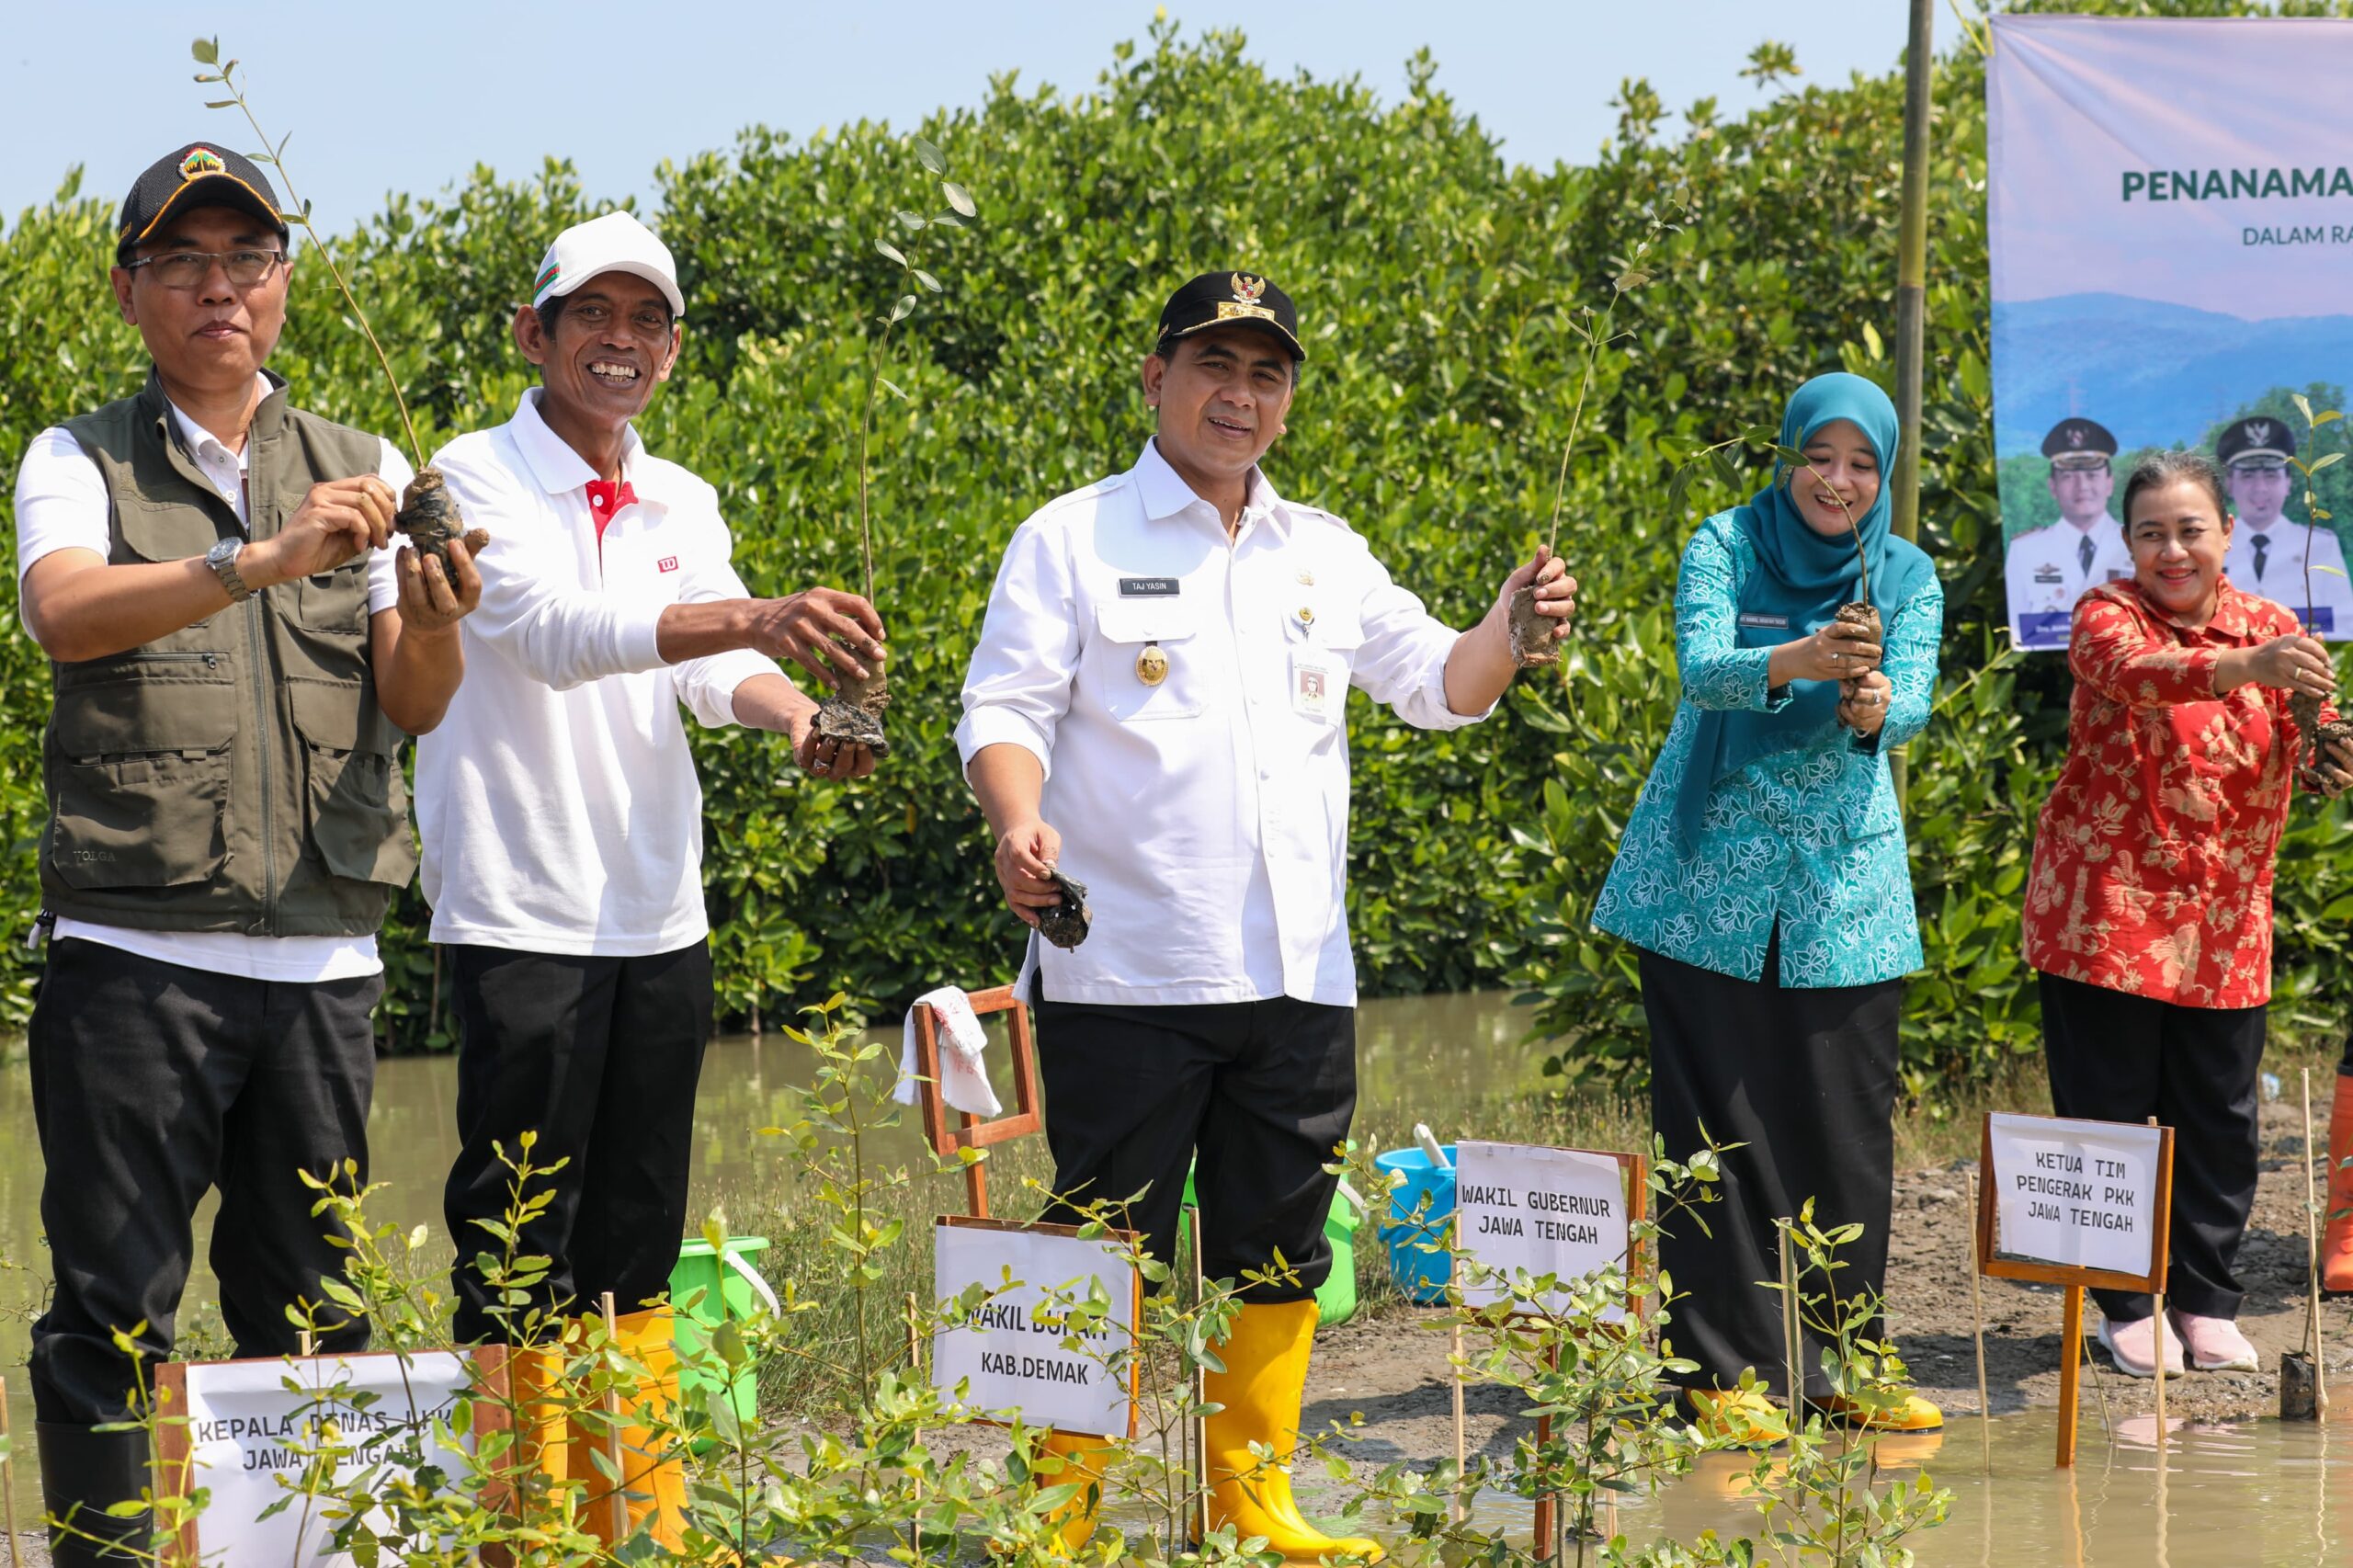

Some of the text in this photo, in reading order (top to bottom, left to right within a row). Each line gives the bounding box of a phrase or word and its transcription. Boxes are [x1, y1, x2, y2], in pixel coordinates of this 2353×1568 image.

[2122, 166, 2353, 201] PENANAMA
[2243, 226, 2325, 245] DALAM
[1132, 582, 1166, 590] TAJ YASIN
[2036, 1152, 2126, 1179] KETUA TIM
[1461, 1185, 1610, 1218] WAKIL GUBERNUR
[2017, 1175, 2134, 1207] PENGERAK PKK
[1478, 1216, 1598, 1244] JAWA TENGAH
[2028, 1201, 2133, 1233] JAWA TENGAH
[982, 1351, 1088, 1385] KAB.DEMAK
[199, 1415, 294, 1443] KEPALA
[309, 1411, 387, 1435] DNAS
[243, 1449, 302, 1471] JAWA
